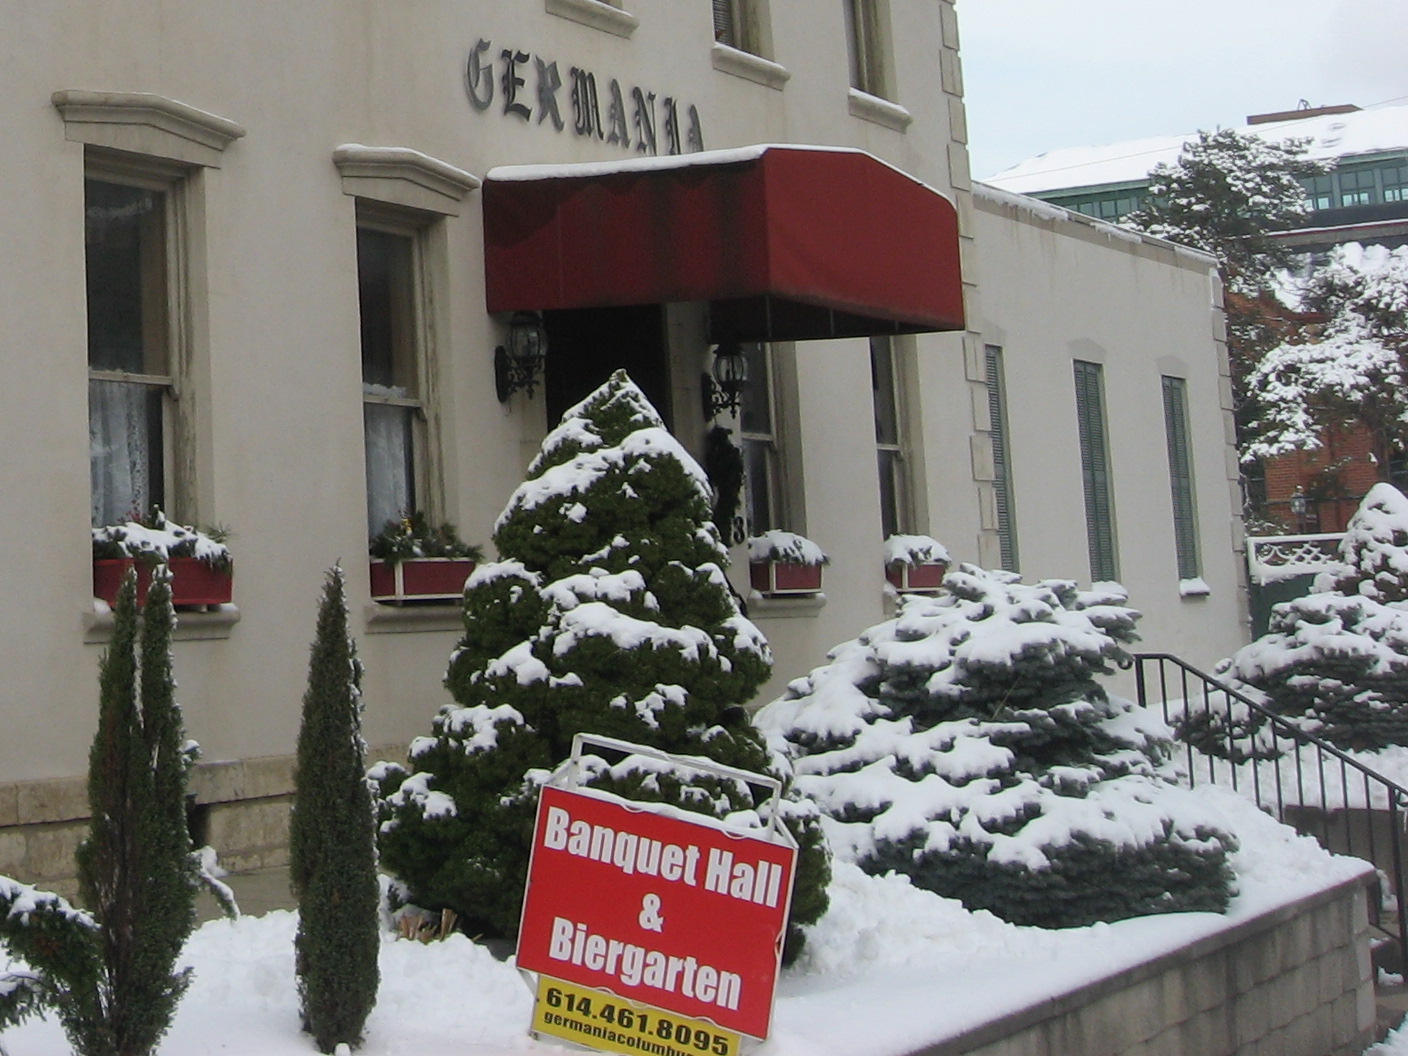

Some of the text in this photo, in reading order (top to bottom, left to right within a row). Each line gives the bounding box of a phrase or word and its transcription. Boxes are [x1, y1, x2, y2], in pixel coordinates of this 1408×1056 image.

[466, 38, 704, 156] GERMANIA
[544, 806, 783, 909] Banquet Hall
[638, 893, 664, 933] &
[549, 916, 741, 1011] Biergarten
[546, 987, 729, 1056] 614.461.8095
